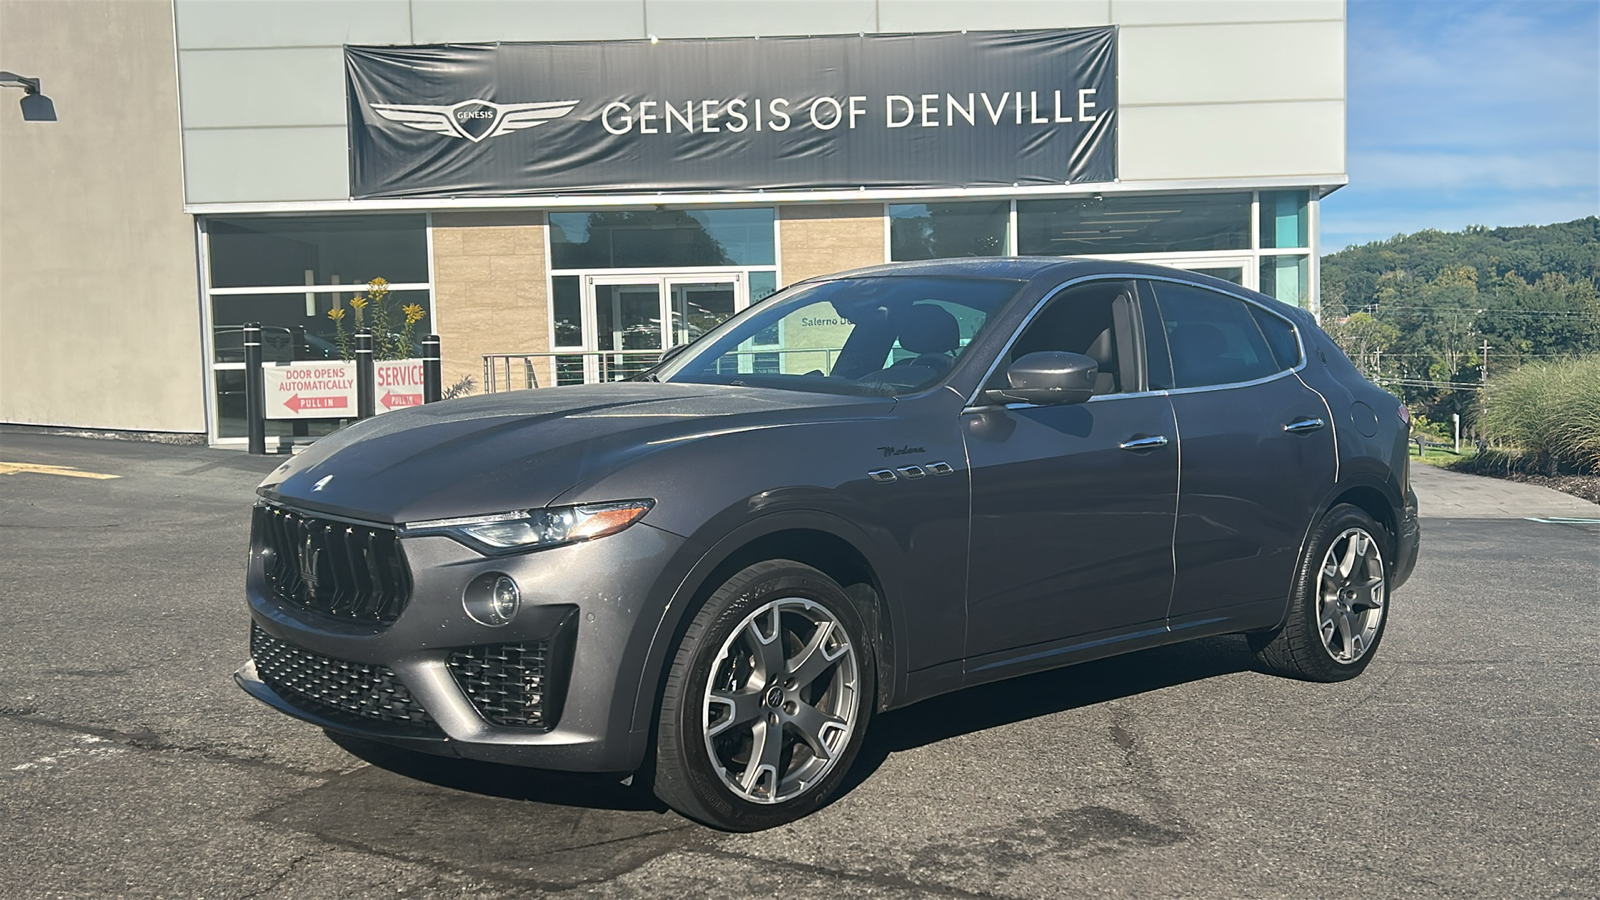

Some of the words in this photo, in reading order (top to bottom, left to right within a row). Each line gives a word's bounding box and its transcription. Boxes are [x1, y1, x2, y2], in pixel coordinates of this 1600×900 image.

[457, 111, 493, 119] GENESIS
[601, 99, 790, 135] GENESIS
[810, 96, 867, 130] OF
[886, 89, 1097, 128] DENVILLE
[801, 317, 838, 327] Salerno
[286, 370, 311, 380] DOOR
[315, 368, 345, 379] OPENS
[377, 365, 424, 386] SERVICE
[279, 379, 353, 391] AUTOMATICALLY
[300, 400, 321, 408] PULL
[323, 399, 333, 407] IN
[391, 396, 406, 405] PULL
